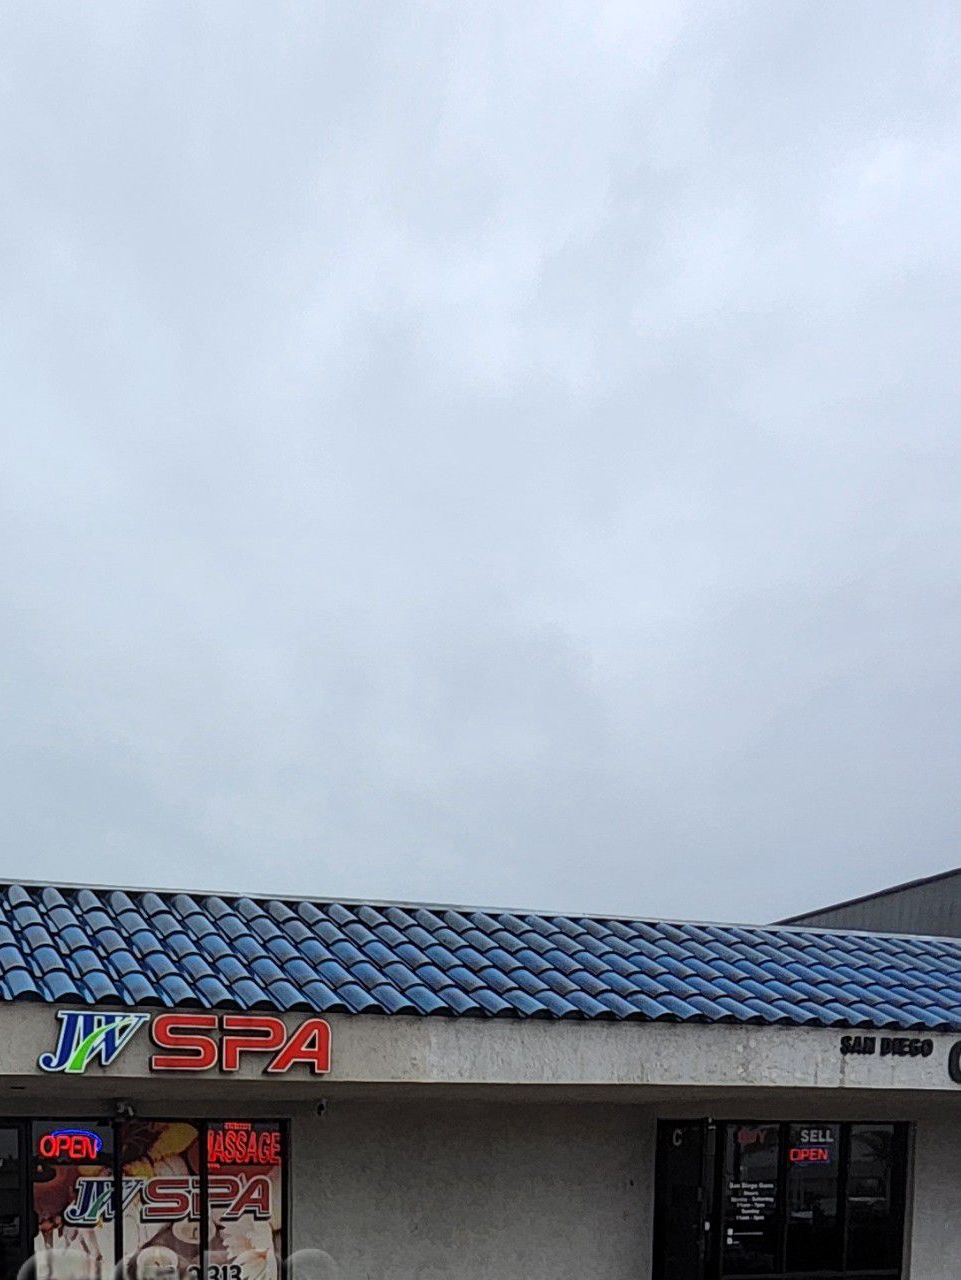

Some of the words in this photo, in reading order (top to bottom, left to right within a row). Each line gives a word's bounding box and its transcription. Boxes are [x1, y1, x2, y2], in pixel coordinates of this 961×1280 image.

[39, 1010, 150, 1073] JW
[152, 1014, 331, 1074] SPA
[840, 1036, 876, 1056] SAN
[879, 1037, 934, 1058] DIEGO
[40, 1134, 98, 1160] OPEN
[800, 1129, 834, 1142] SELL
[789, 1148, 829, 1162] OPEN
[141, 1176, 272, 1223] SPA
